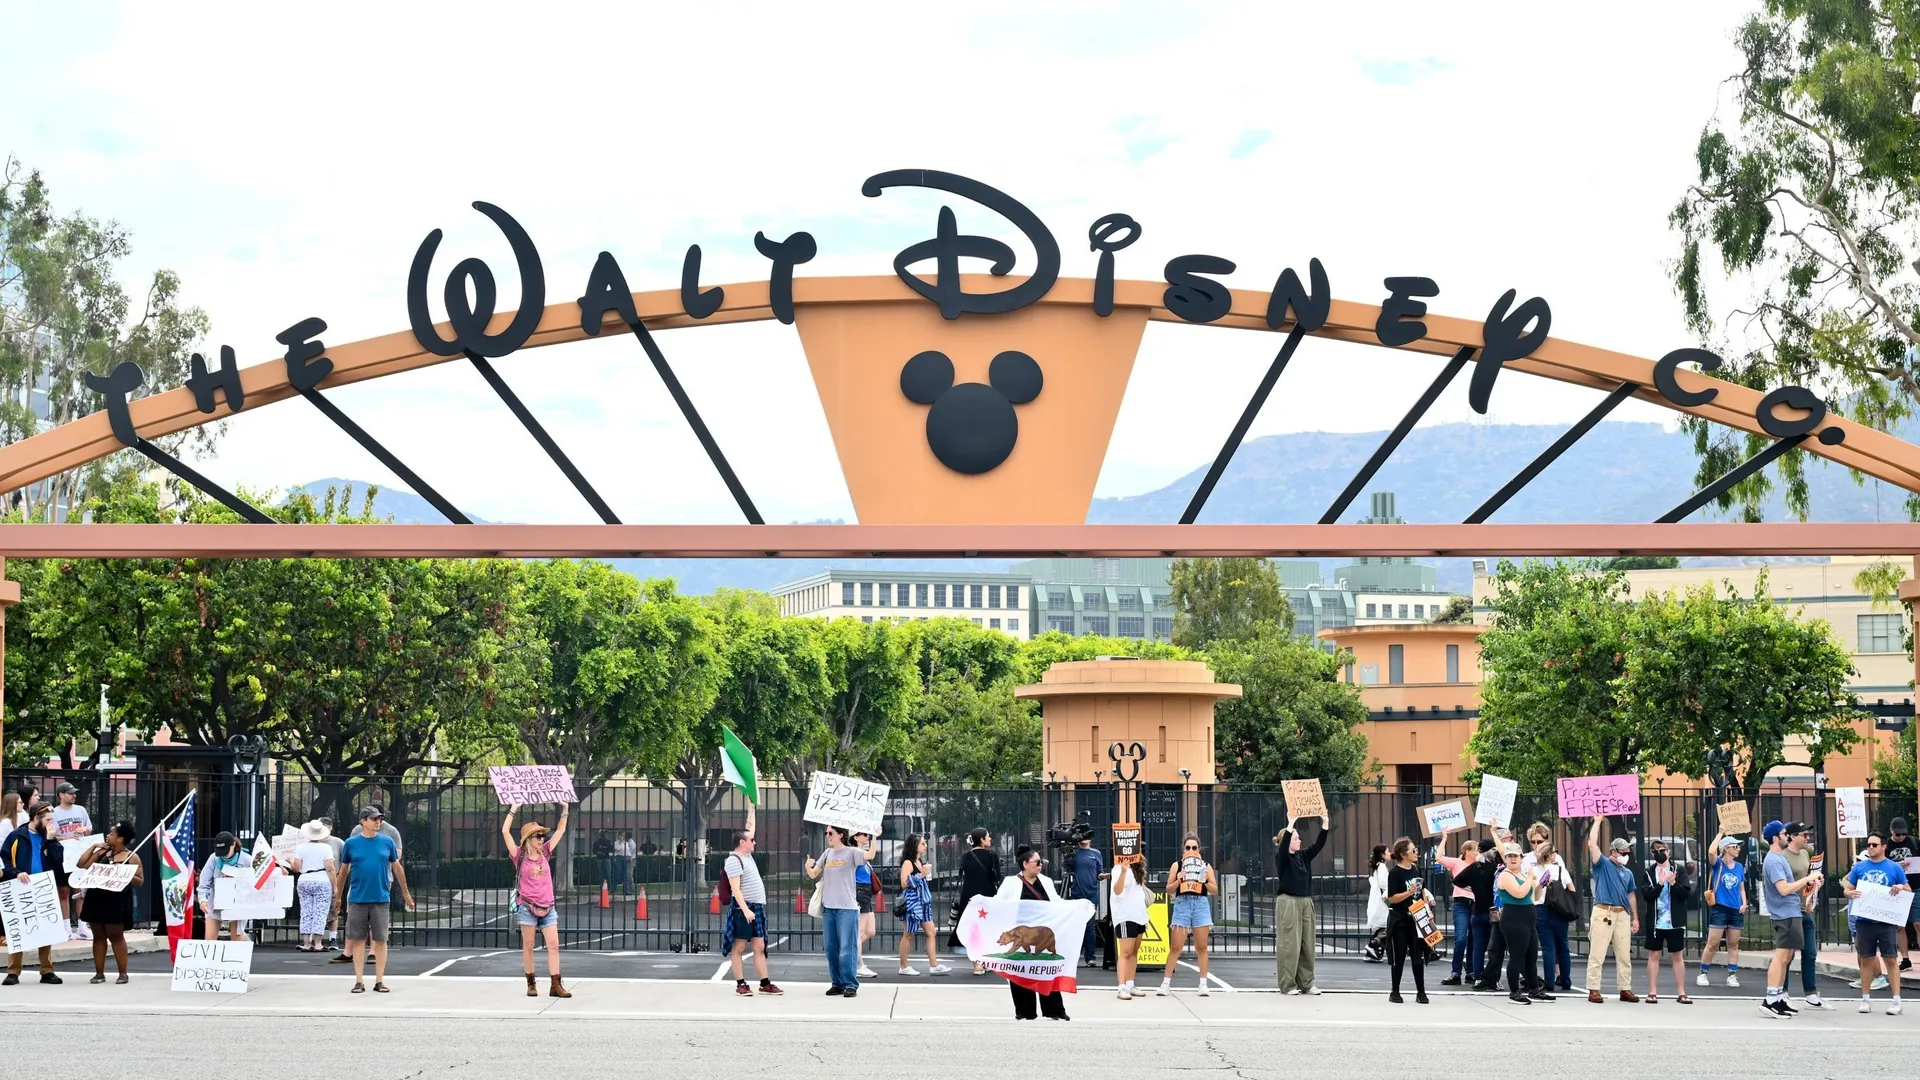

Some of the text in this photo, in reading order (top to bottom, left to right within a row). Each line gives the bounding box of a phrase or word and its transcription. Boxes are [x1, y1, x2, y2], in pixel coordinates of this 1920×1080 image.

[85, 317, 334, 447] THE
[407, 200, 817, 357] WALT
[490, 766, 510, 777] We
[814, 774, 885, 807] NEXSTAR
[1561, 779, 1618, 799] Protect
[500, 789, 579, 804] REVOLUTION
[1720, 803, 1740, 813] FIRST
[1114, 830, 1140, 838] TRUMP
[1117, 838, 1137, 847] MUST
[1122, 847, 1133, 855] GO
[89, 865, 114, 877] YOUR
[101, 880, 128, 889] NEXT
[0, 881, 17, 914] FUNNY
[33, 872, 59, 924] TRUMP
[18, 890, 39, 935] HATES
[1859, 899, 1903, 921] COWARDS
[180, 943, 243, 964] CIVIL
[1139, 946, 1167, 954] STRIAN
[1138, 954, 1160, 962] AFFIC
[195, 980, 222, 992] NOW
